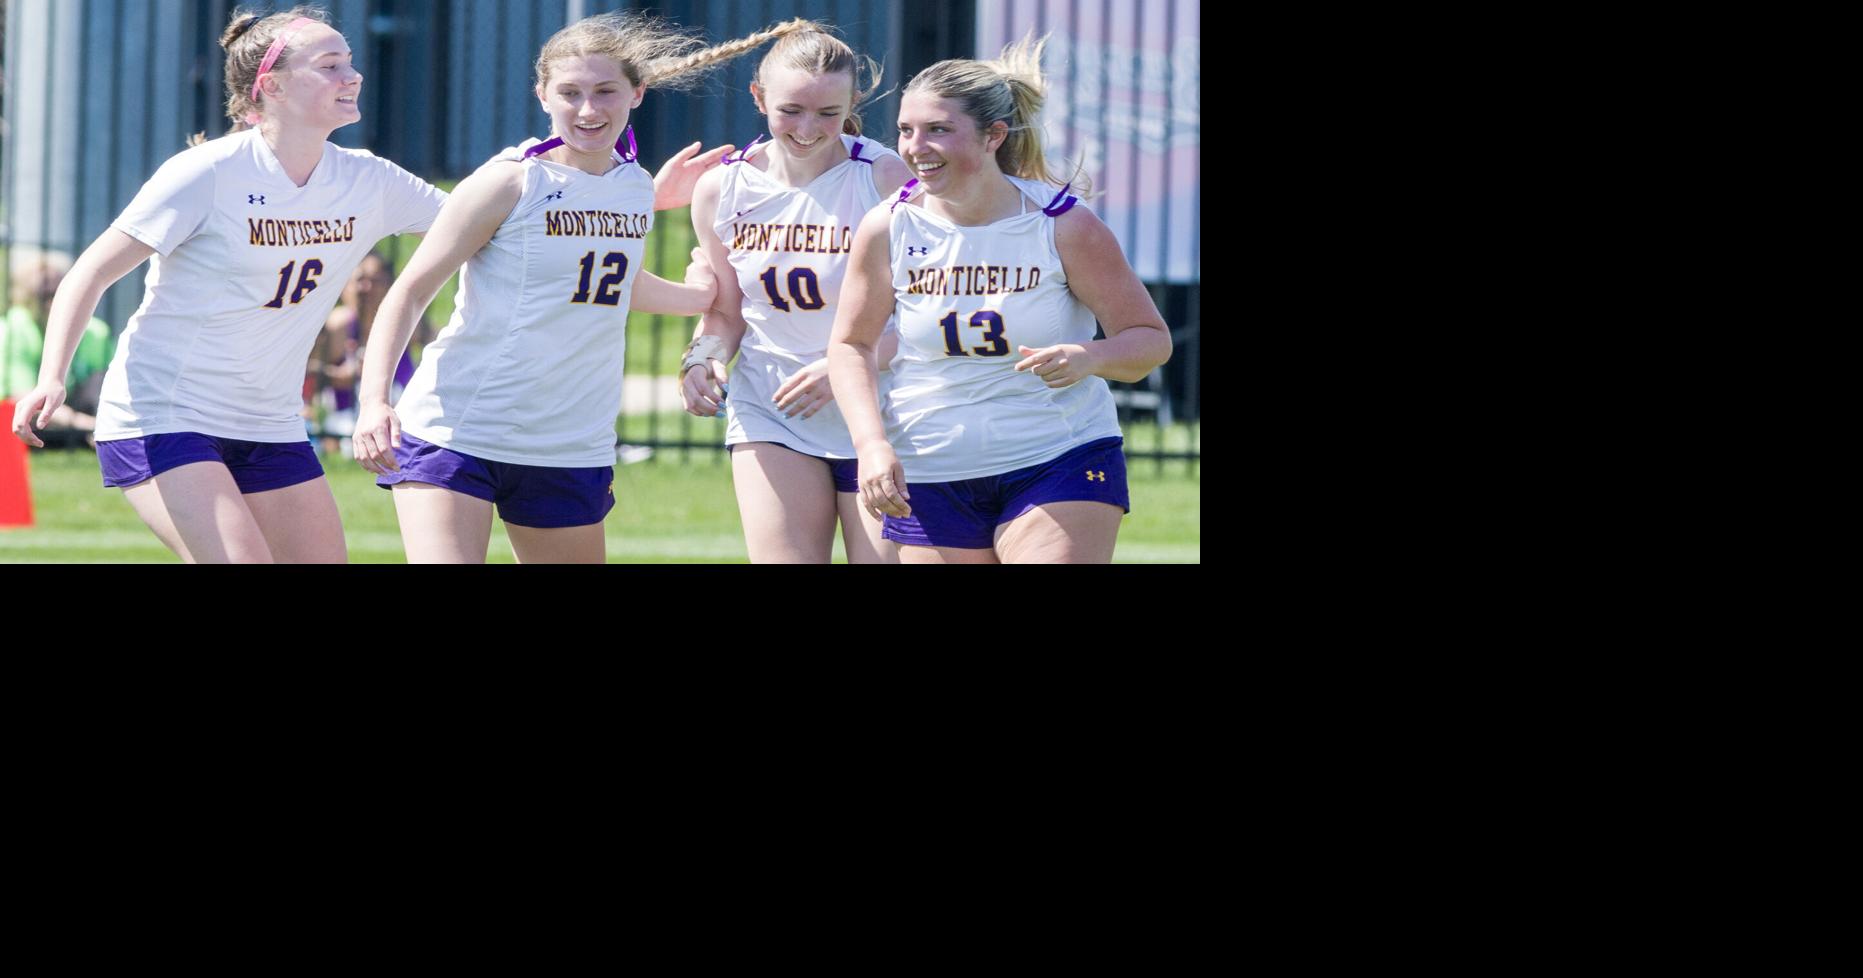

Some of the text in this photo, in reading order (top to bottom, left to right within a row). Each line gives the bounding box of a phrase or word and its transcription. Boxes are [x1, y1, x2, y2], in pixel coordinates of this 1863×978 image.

[248, 216, 355, 246] MONTICELLO
[545, 209, 648, 239] MONTICELLO
[733, 223, 851, 254] MONTICELLO
[262, 258, 323, 309] 16
[569, 250, 629, 306] 12
[759, 265, 826, 312] 10
[907, 265, 1041, 296] MONTICELLO
[939, 310, 1010, 357] 13
